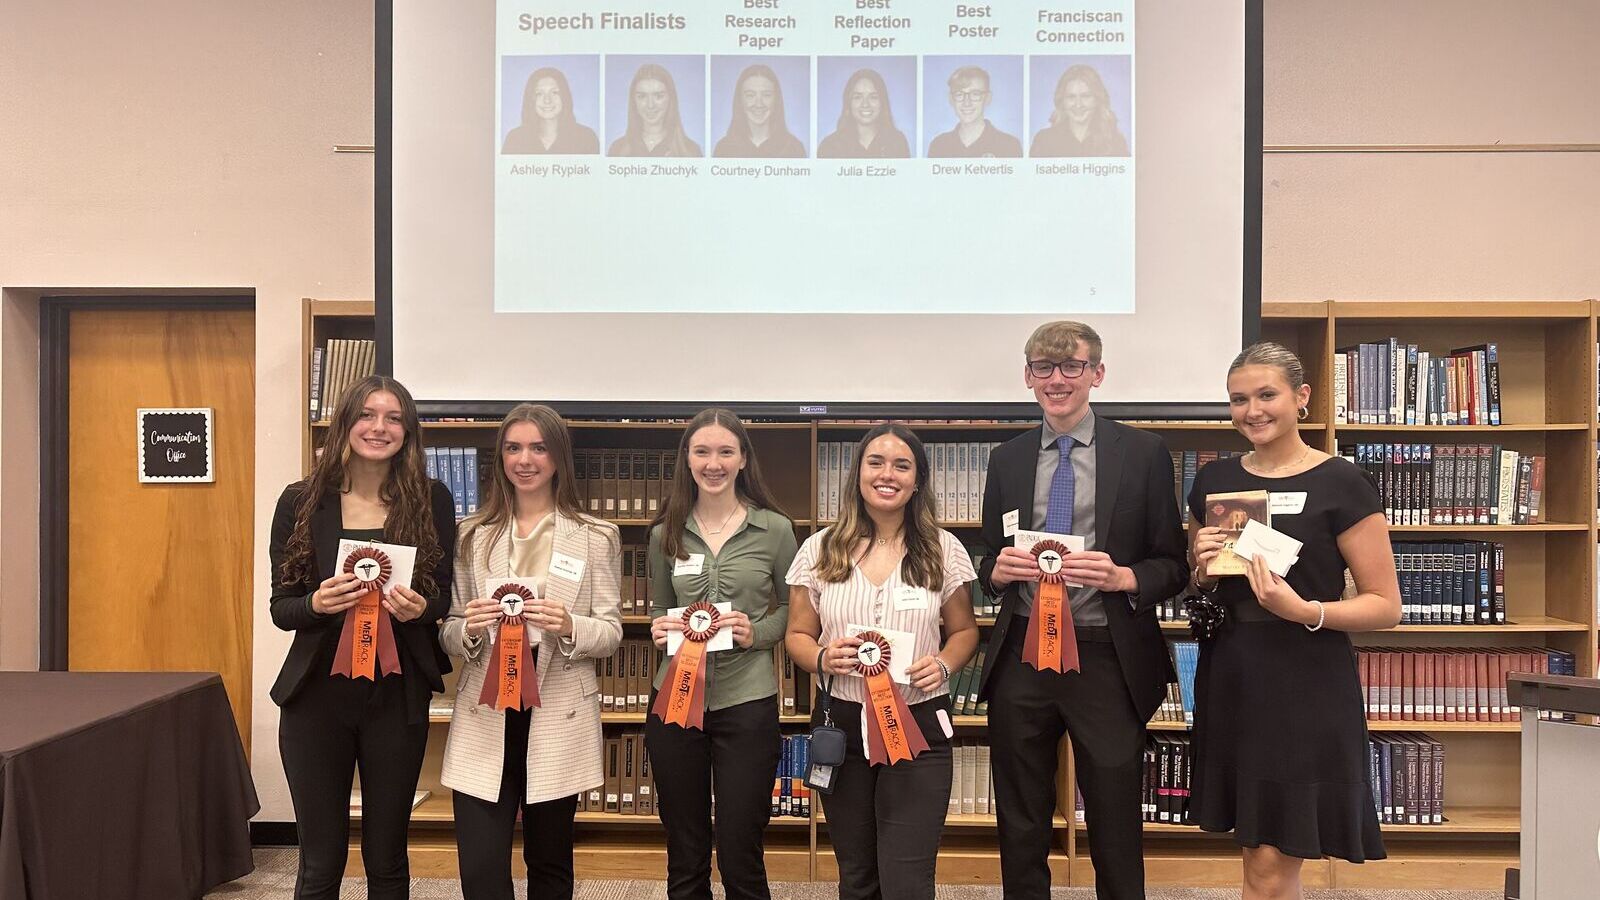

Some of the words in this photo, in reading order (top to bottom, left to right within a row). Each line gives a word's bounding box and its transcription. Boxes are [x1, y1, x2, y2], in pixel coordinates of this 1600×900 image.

[744, 0, 778, 9] Best
[856, 0, 890, 9] Best
[956, 4, 991, 18] Best
[518, 12, 594, 34] Speech
[600, 12, 686, 30] Finalists
[725, 14, 796, 28] Research
[834, 15, 910, 29] Reflection
[1038, 10, 1122, 23] Franciscan
[948, 24, 998, 38] Poster
[1036, 29, 1124, 43] Connection
[738, 34, 783, 50] Paper
[850, 35, 895, 51] Paper
[510, 164, 549, 177] Ashley
[552, 164, 590, 177] Rypiak
[608, 164, 648, 178] Sophia
[650, 164, 698, 178] Zhuchyk
[710, 165, 762, 178] Courtney
[764, 165, 810, 177] Dunham
[837, 166, 864, 177] Julia
[866, 166, 896, 177] Ezzie
[932, 164, 962, 176] Drew
[964, 164, 1014, 176] Ketvertis
[1036, 164, 1080, 175] Isabella
[1082, 164, 1126, 178] Higgins
[151, 430, 200, 445] Communication
[166, 447, 186, 462] Office
[1500, 484, 1509, 512] STATES
